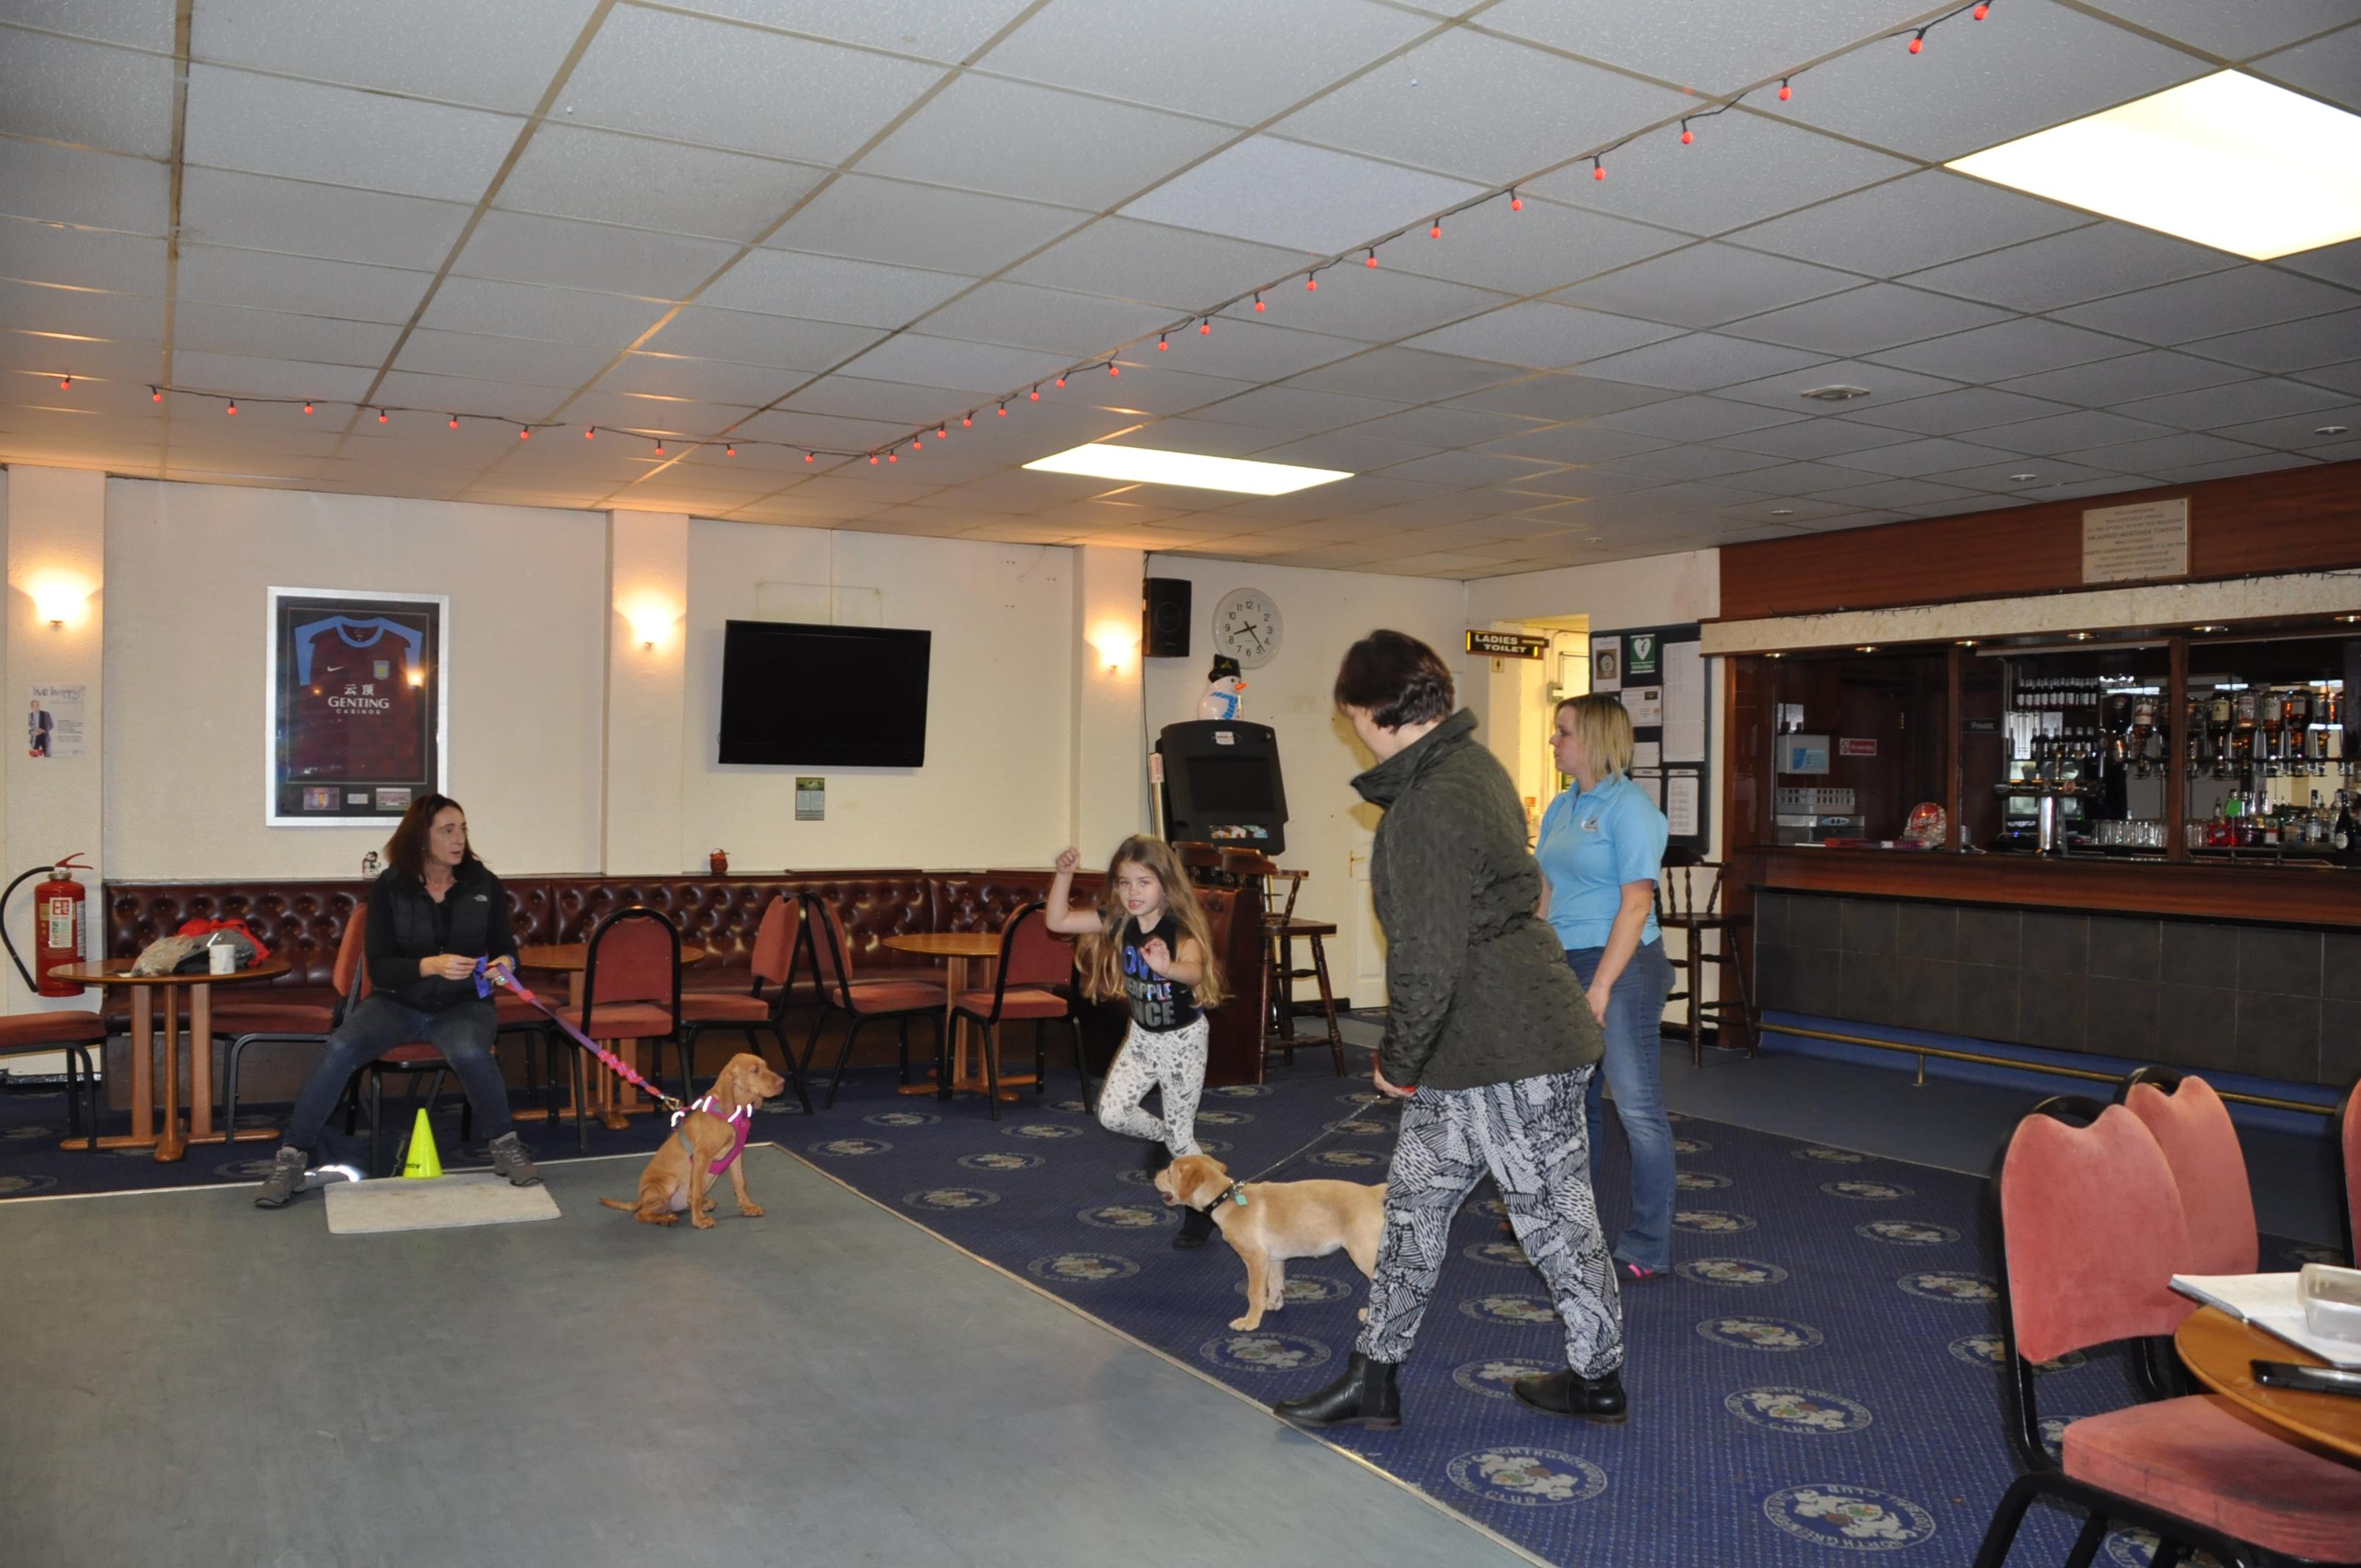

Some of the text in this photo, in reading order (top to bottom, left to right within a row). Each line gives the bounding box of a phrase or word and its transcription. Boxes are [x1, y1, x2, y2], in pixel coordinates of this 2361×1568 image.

[1236, 603, 1242, 611] 11
[1246, 601, 1253, 609] 12
[1258, 604, 1261, 612] 1
[1229, 611, 1236, 620] 10
[1263, 614, 1269, 622] 2
[1225, 623, 1230, 632] 9
[1267, 626, 1272, 634] 3
[1229, 636, 1234, 645] 8
[1475, 634, 1518, 645] LADIES
[1236, 645, 1242, 653] 7
[1246, 648, 1252, 657] 6
[1484, 644, 1527, 653] TOILET
[344, 683, 374, 696] 云顶
[327, 696, 390, 709] GENTING
[1827, 1486, 1879, 1498] CLUB
[1485, 1491, 1536, 1505] CLUB
